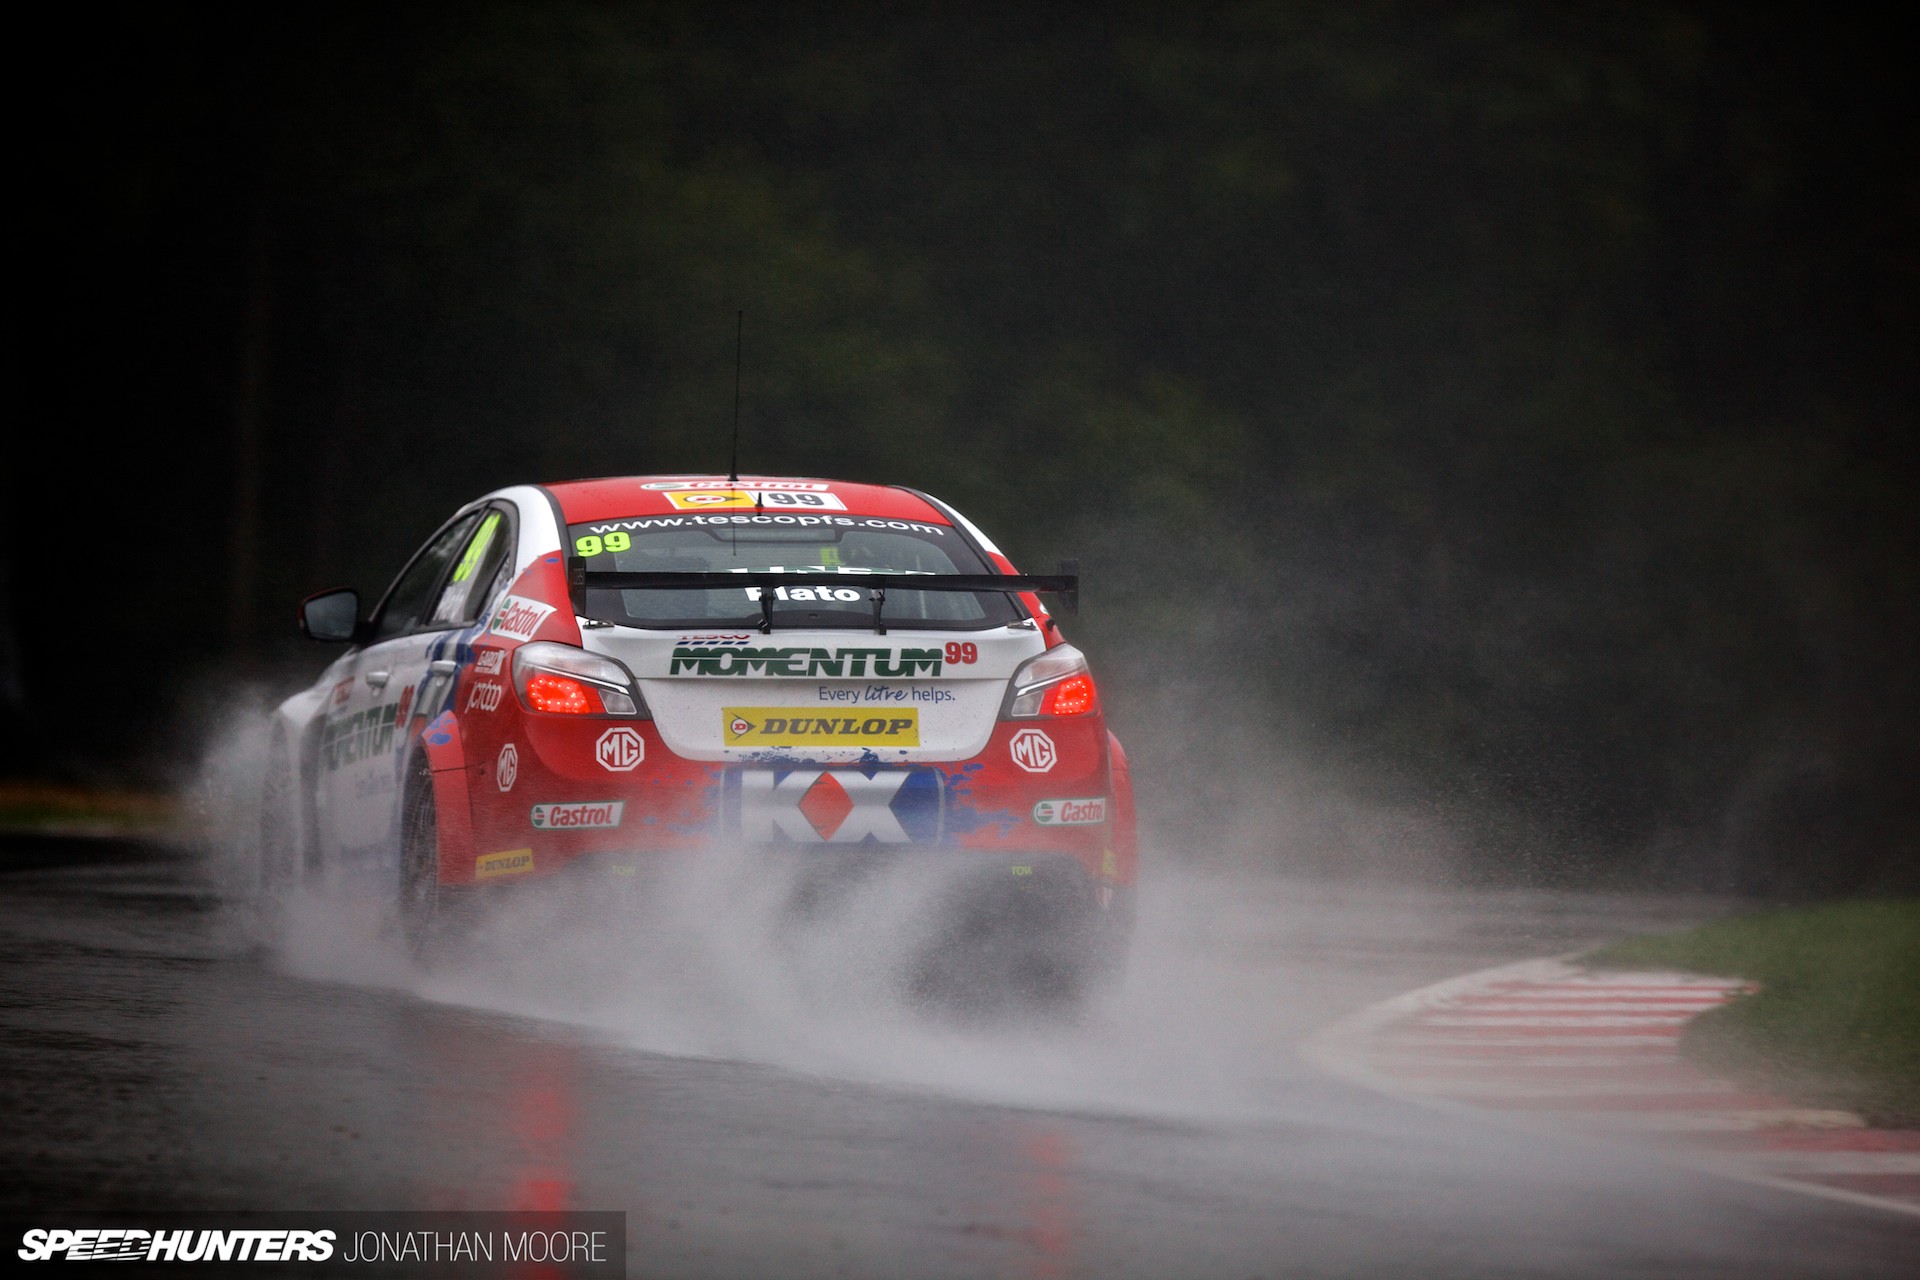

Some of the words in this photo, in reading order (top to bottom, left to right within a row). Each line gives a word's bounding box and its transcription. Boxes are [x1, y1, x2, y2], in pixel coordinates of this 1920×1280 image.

[768, 493, 825, 506] 99
[590, 514, 944, 536] www.tescopfs.com
[576, 531, 631, 557] 99
[500, 600, 543, 637] Castrol
[669, 647, 944, 677] MOMENTUM
[945, 642, 978, 665] 99
[818, 686, 860, 704] Every
[864, 684, 908, 701] litre
[911, 686, 956, 704] helps.
[759, 718, 913, 735] DUNLOP
[601, 733, 640, 767] MG
[1014, 734, 1052, 768] MG
[550, 804, 613, 827] Castrol
[484, 855, 531, 873] DUNLOP
